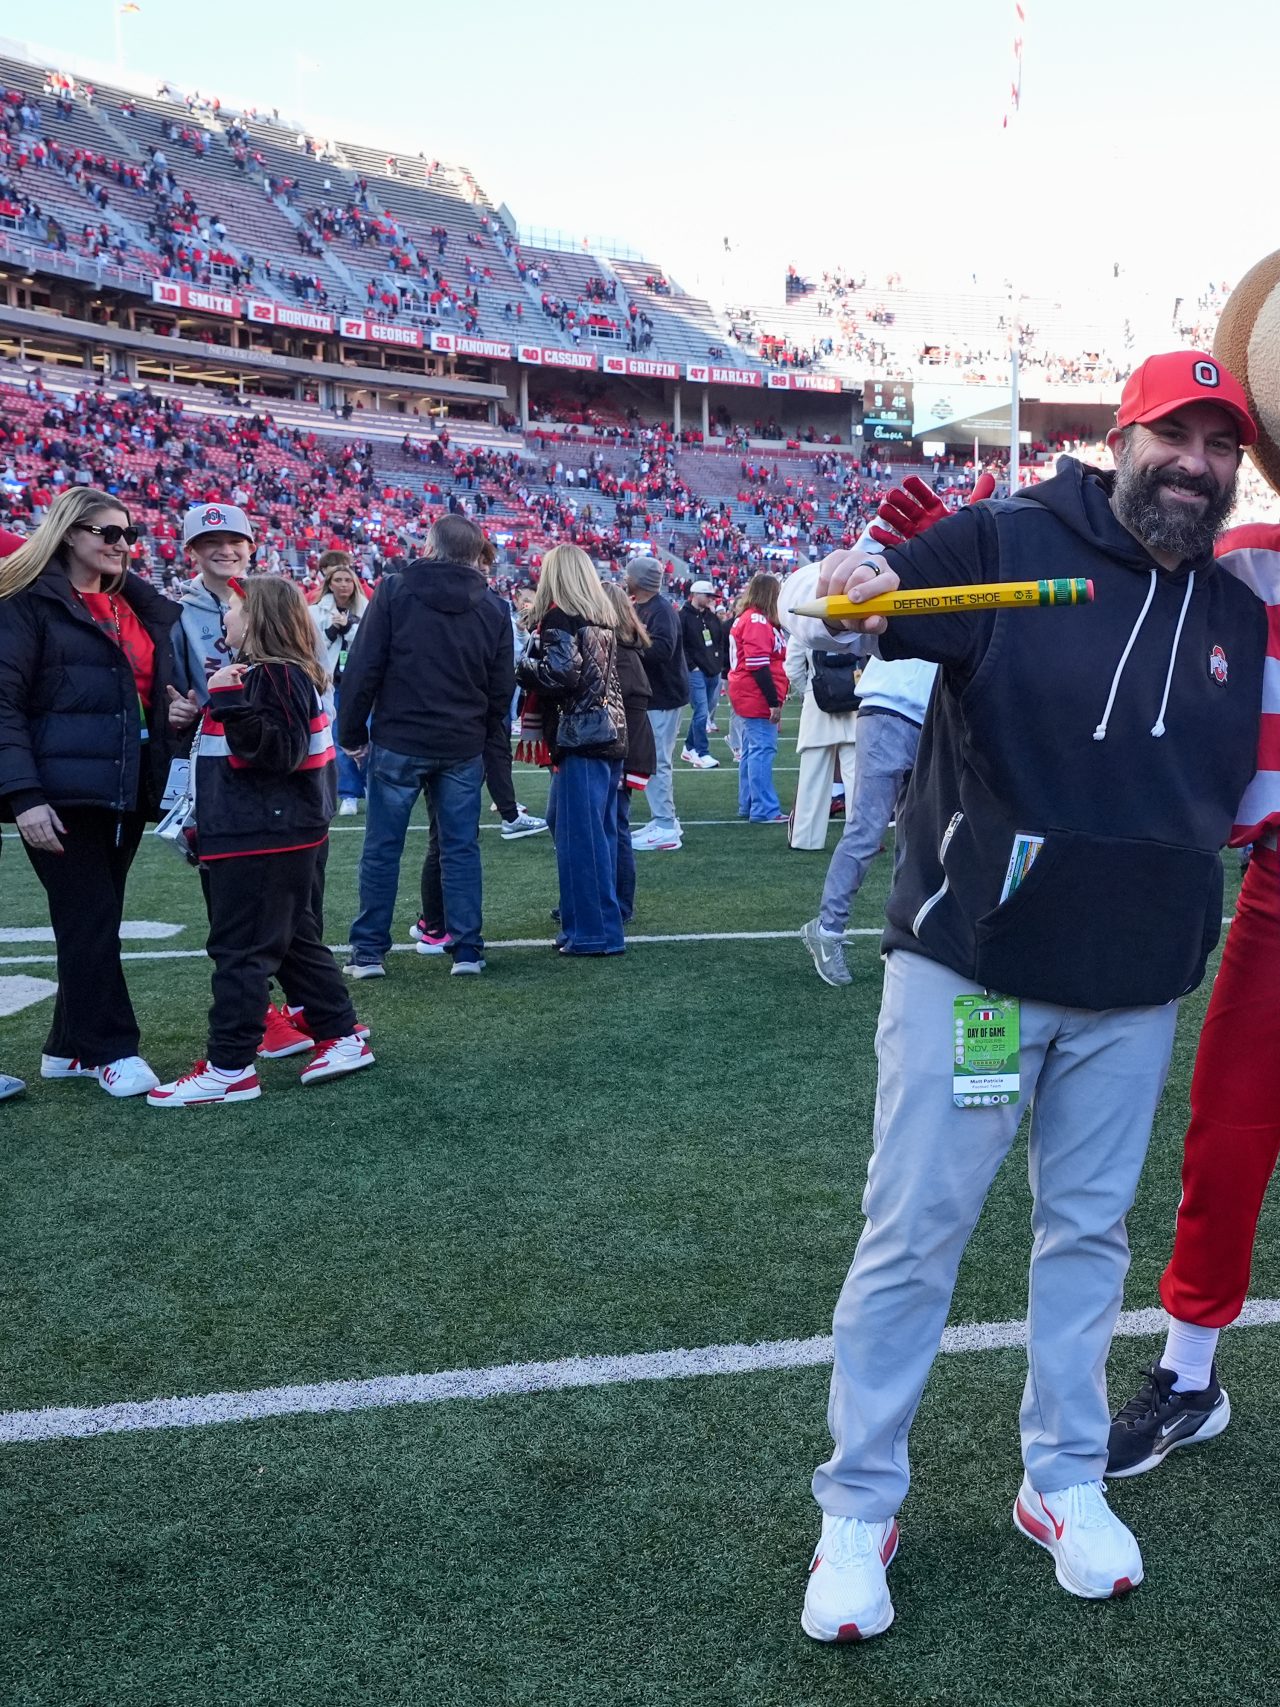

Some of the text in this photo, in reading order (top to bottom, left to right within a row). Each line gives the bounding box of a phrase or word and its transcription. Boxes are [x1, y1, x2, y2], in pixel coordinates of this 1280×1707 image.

[160, 286, 233, 313] 10 SMITH
[254, 305, 331, 331] 22 HORVATH
[345, 322, 418, 344] 27 GEORGE
[456, 338, 511, 358] JANOWICZ
[522, 348, 593, 367] 40 CASSADY
[607, 359, 675, 377] 45 GRIFFIN
[690, 368, 757, 384] 47 HARLEY
[1192, 360, 1219, 388] O
[771, 375, 786, 386] 99
[892, 396, 906, 408] 42
[893, 597, 940, 610] DEFEND
[941, 594, 965, 606] THE
[1025, 589, 1033, 600] HB
[750, 613, 767, 625] 90
[967, 1026, 1005, 1038] DAY OF GAME
[992, 1044, 1005, 1052] 22
